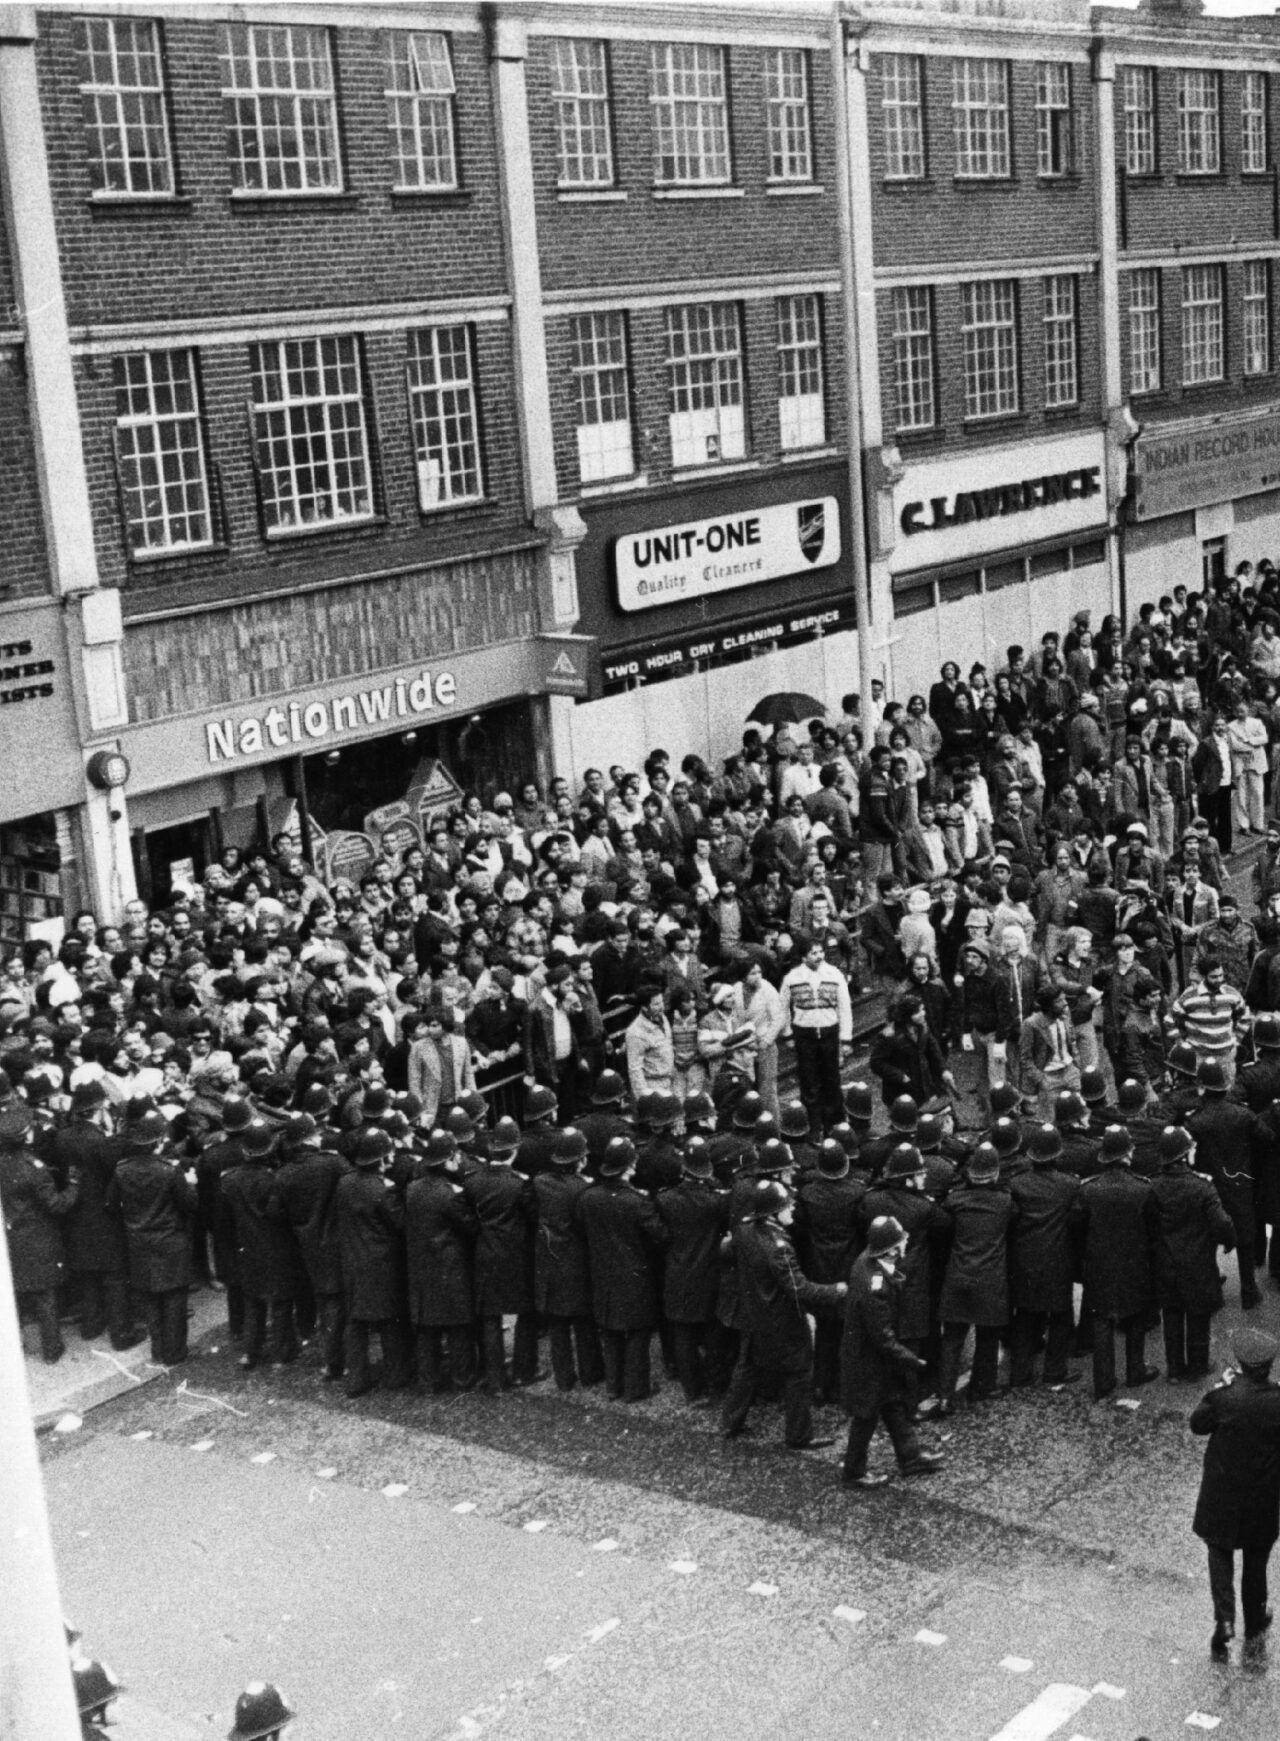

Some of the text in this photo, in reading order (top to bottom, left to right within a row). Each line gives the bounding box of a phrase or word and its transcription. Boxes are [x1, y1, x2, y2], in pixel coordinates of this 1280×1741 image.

[1195, 431, 1249, 462] RECORD
[634, 517, 761, 568] UNIT-ONE
[637, 557, 763, 596] Quality Cleaners
[0, 640, 33, 657] TS
[606, 609, 841, 679] TWO HOUR DRY CLEANING SERVICE
[0, 660, 55, 680] NER
[207, 672, 457, 762] Nationwide
